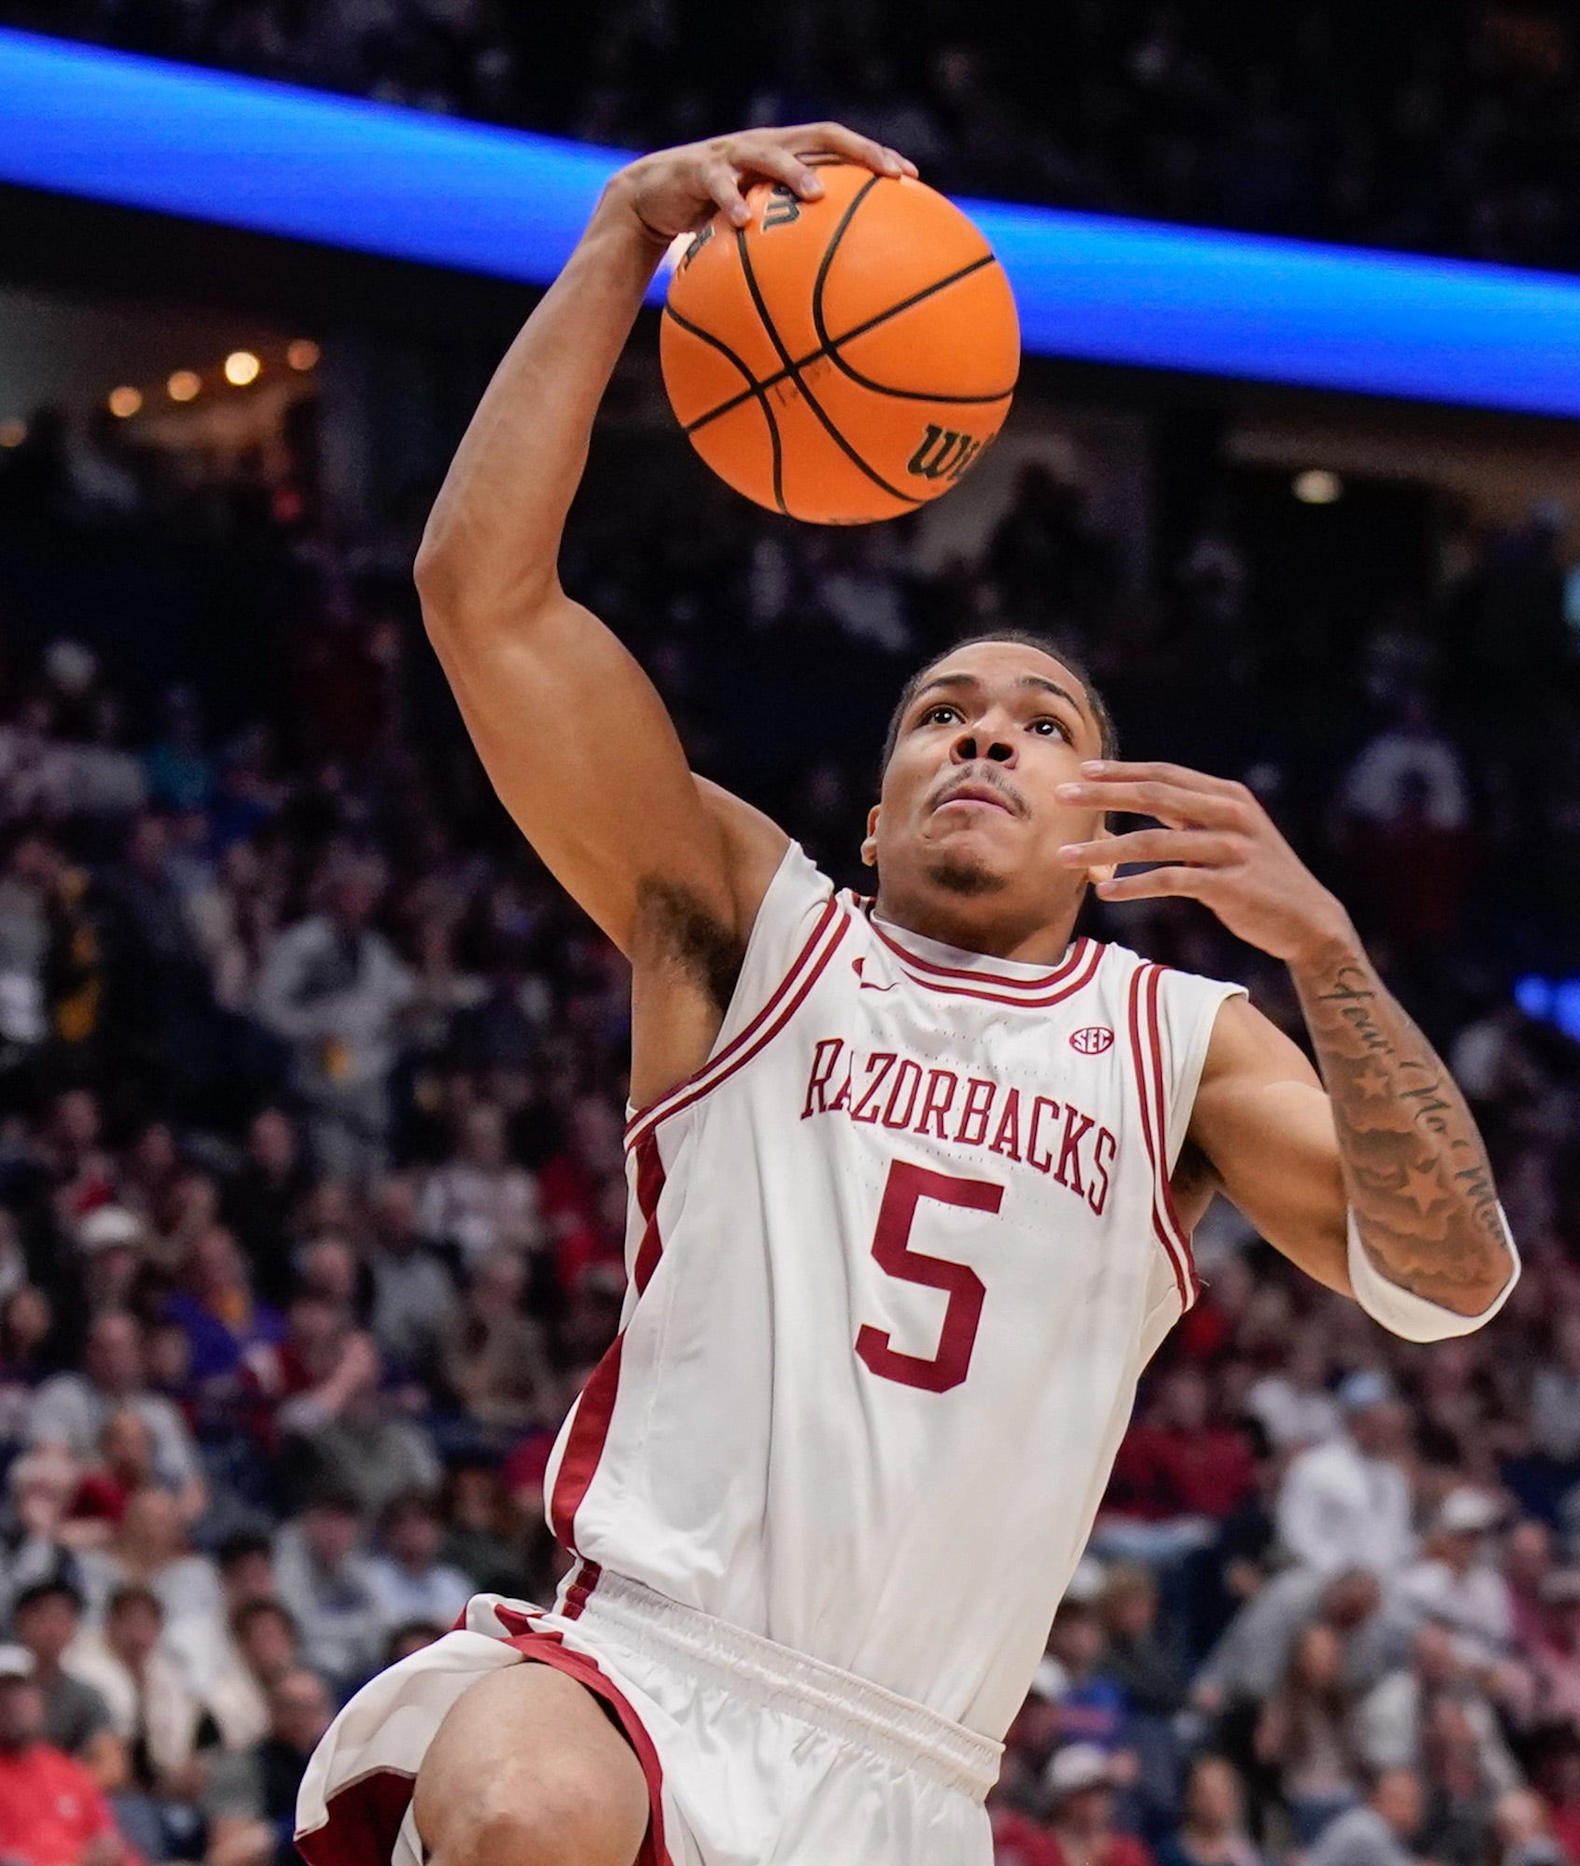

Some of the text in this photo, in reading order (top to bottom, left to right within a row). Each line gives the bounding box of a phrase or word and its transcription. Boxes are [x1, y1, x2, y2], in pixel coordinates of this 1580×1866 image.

[907, 424, 992, 481] Wi
[1071, 1028, 1112, 1054] SEC
[800, 1037, 1117, 1217] RAZORBACKS
[854, 1158, 1005, 1394] 5
